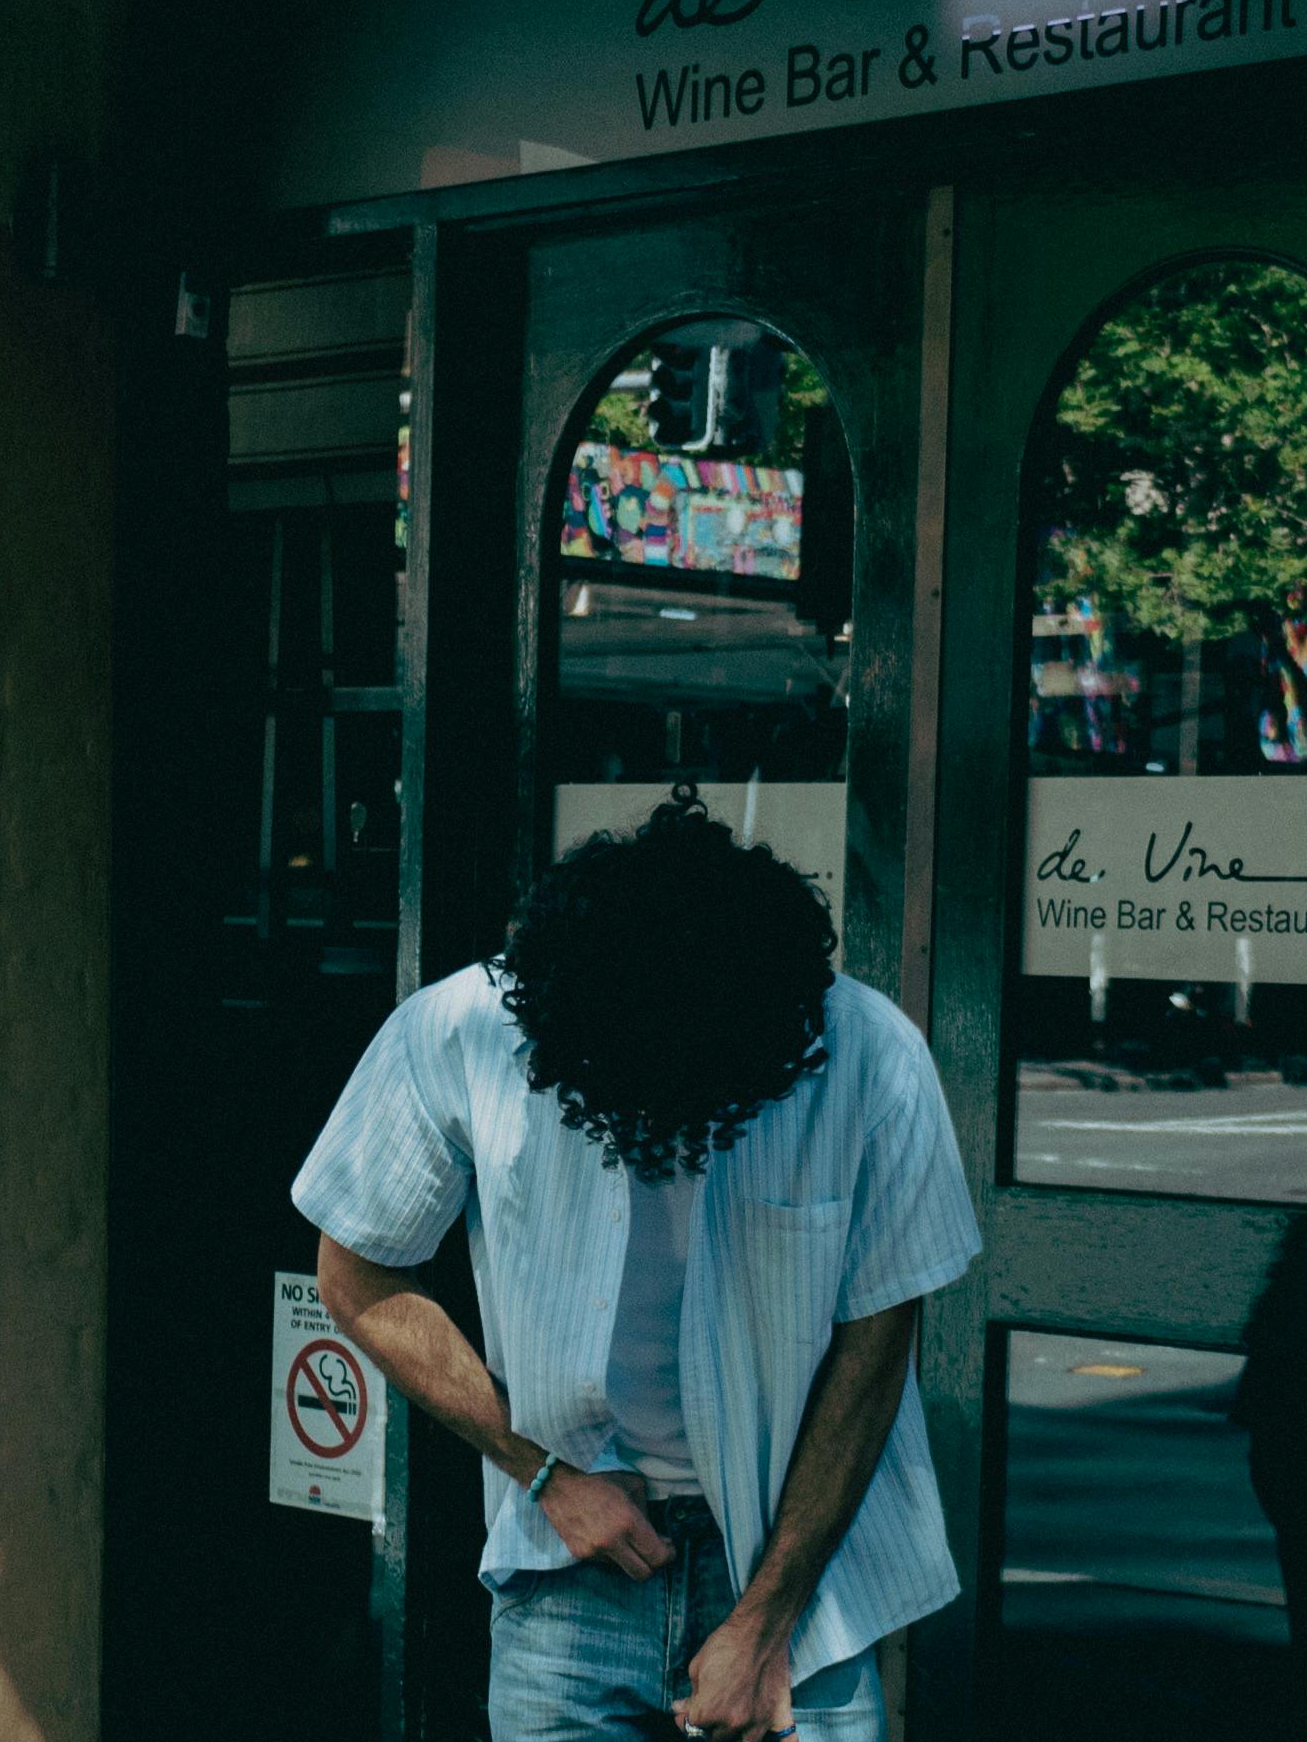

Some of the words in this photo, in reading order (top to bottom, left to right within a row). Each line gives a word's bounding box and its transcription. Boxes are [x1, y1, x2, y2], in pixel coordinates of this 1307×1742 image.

[635, 65, 767, 132] Wine
[785, 41, 882, 110] Bar
[896, 22, 940, 91] &
[1036, 828, 1106, 884] de
[1036, 897, 1107, 930] Wine
[1116, 900, 1167, 931] Bar
[1175, 901, 1196, 932] &
[281, 1283, 304, 1302] NO
[292, 1306, 323, 1318] WITHIN
[290, 1319, 302, 1330] OF
[304, 1321, 332, 1333] ENTRY
